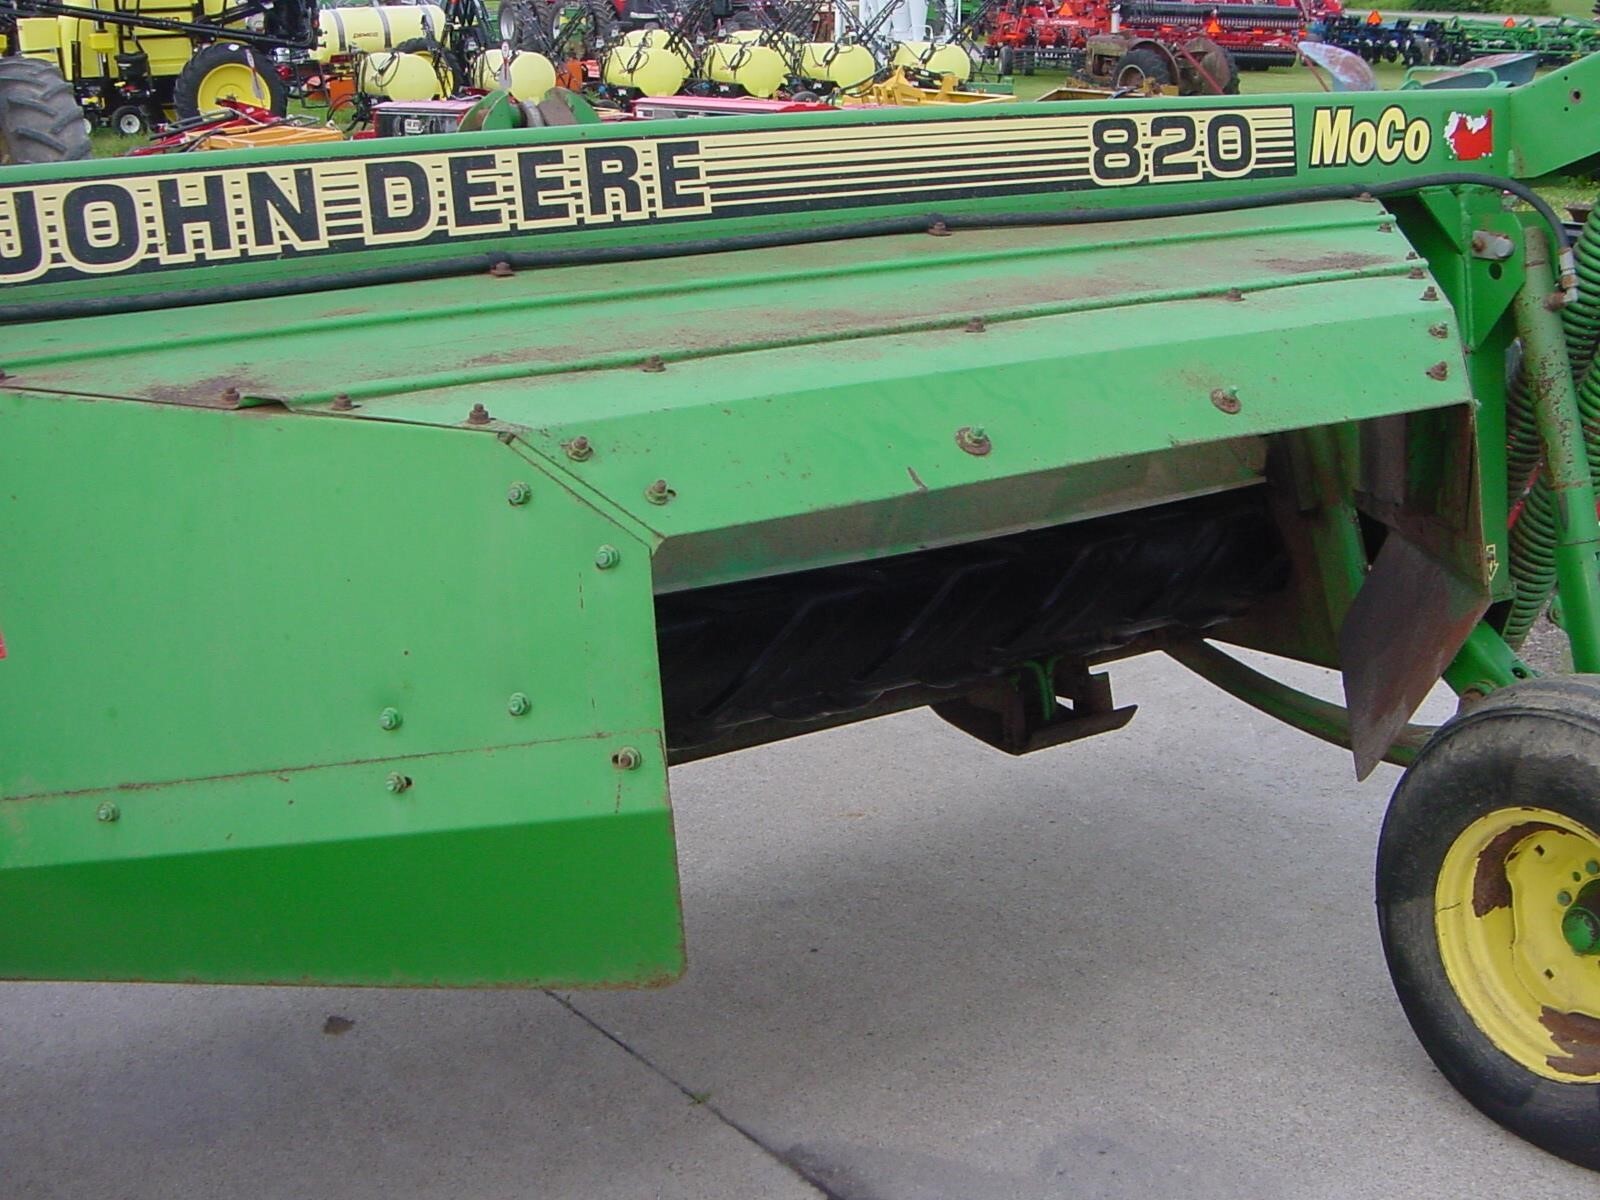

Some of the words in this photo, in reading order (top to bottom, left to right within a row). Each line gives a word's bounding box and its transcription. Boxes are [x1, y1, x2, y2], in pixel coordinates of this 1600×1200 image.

[1309, 105, 1432, 169] MoCo
[0, 166, 329, 283] JOHN
[364, 139, 712, 245] DEERE
[1089, 112, 1256, 186] 820
